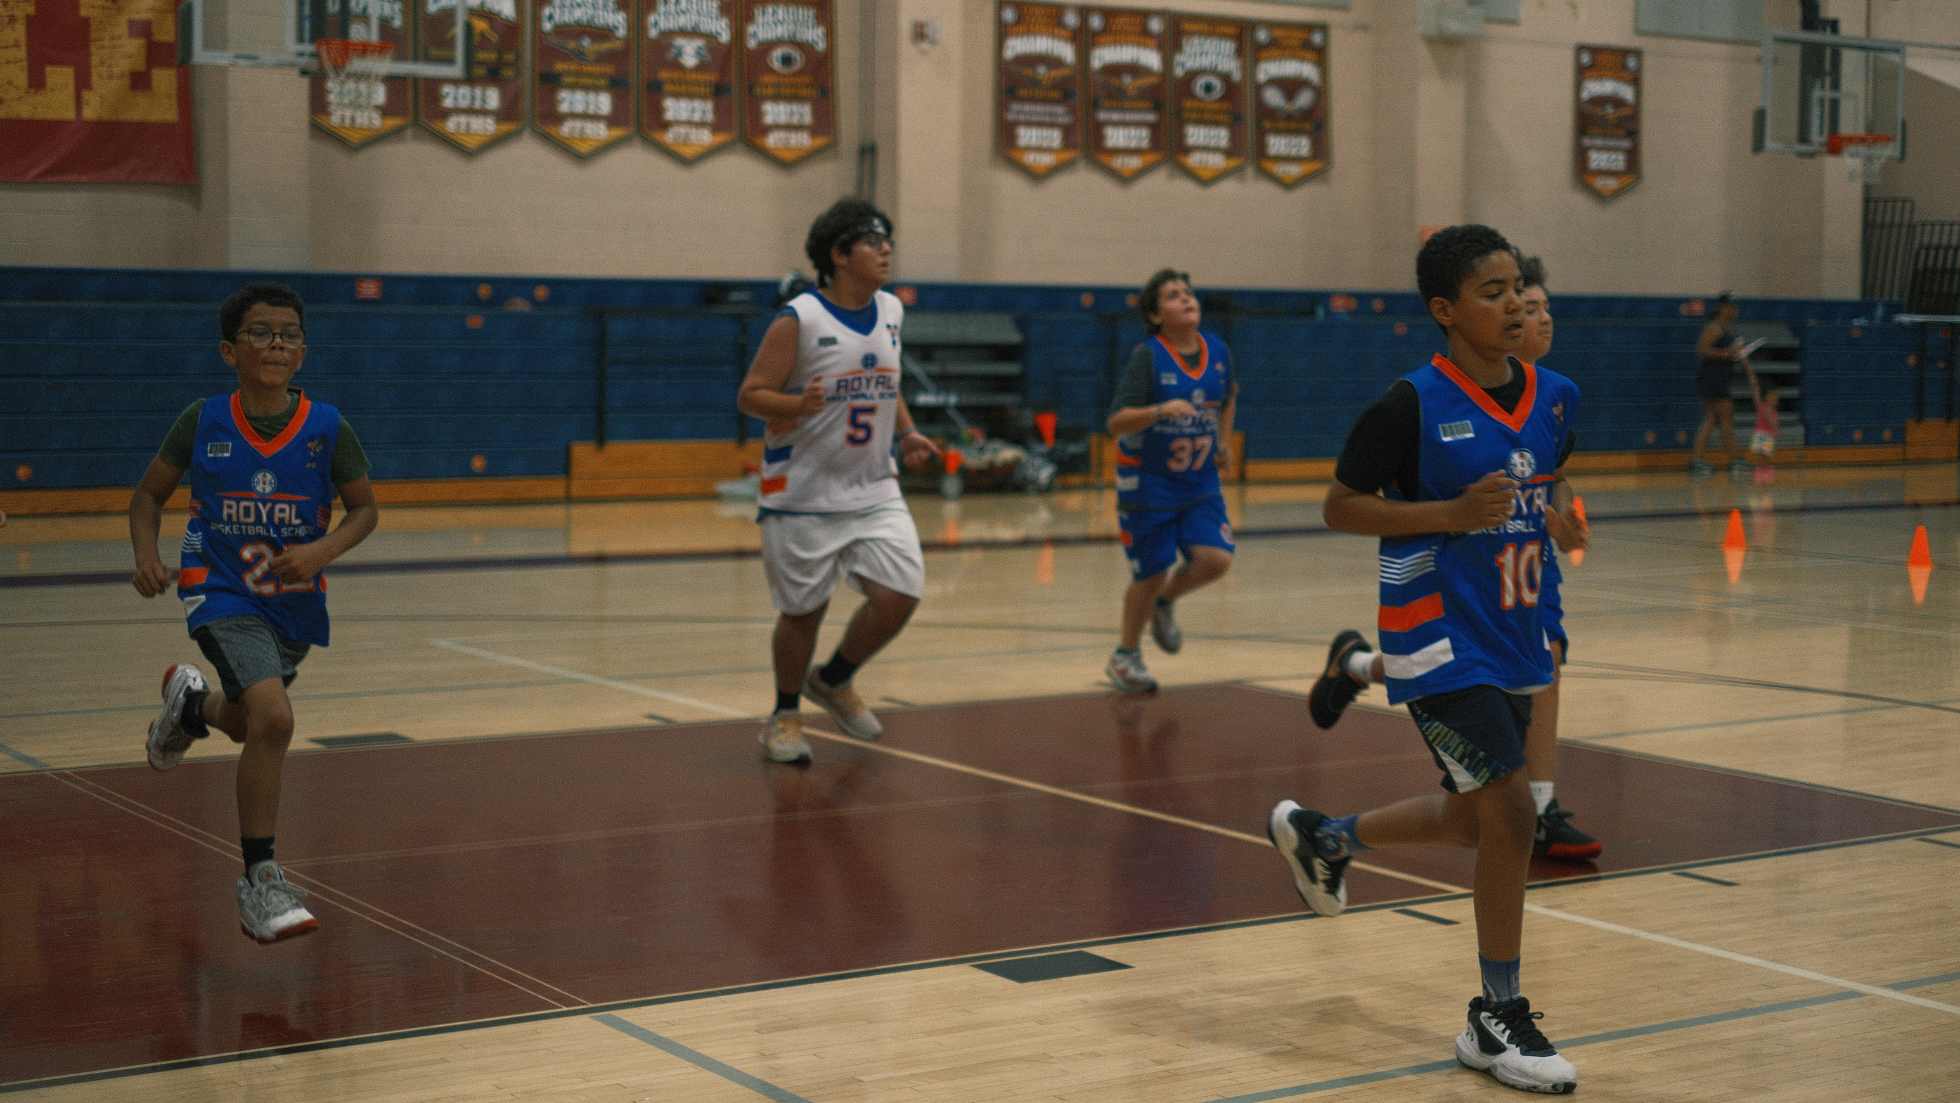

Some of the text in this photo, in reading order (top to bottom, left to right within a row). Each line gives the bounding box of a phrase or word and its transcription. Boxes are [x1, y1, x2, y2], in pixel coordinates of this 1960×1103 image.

[836, 374, 896, 395] ROYAL
[845, 404, 879, 447] 5
[1166, 435, 1213, 473] 37
[223, 499, 303, 525] ROYAL
[1495, 541, 1544, 610] 10
